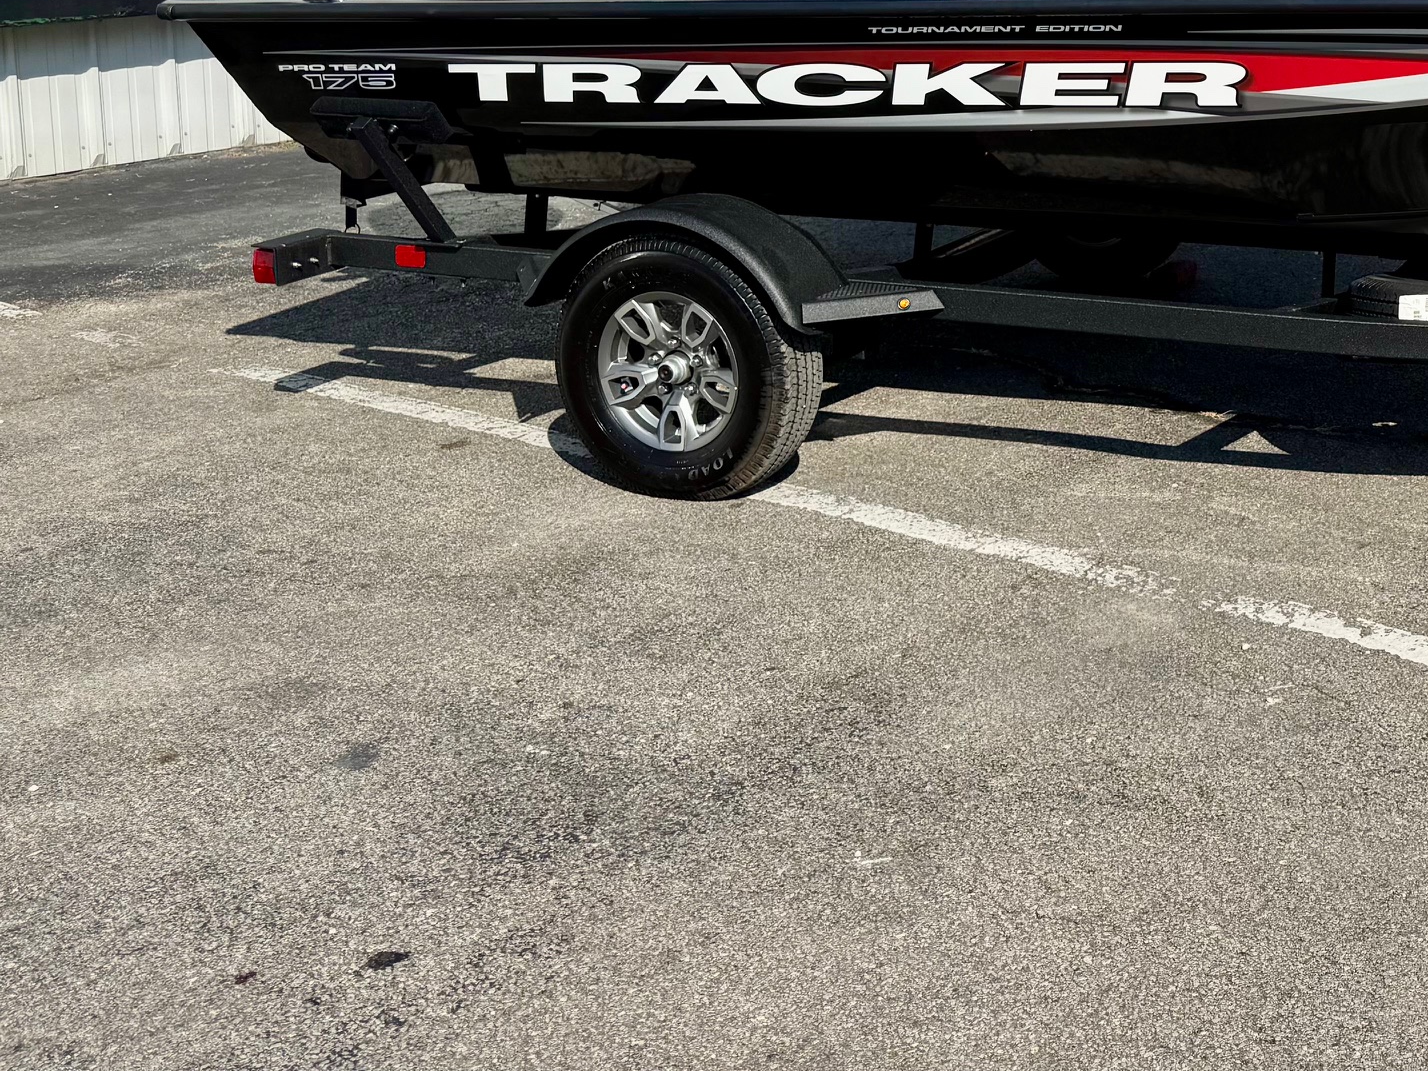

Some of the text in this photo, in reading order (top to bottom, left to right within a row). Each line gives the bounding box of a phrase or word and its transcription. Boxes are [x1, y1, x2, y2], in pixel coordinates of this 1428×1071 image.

[868, 24, 1123, 34] TOURNAMENT EDITION
[278, 63, 397, 72] PRO TEAM
[301, 73, 397, 90] 175
[448, 62, 1248, 107] TRACKER
